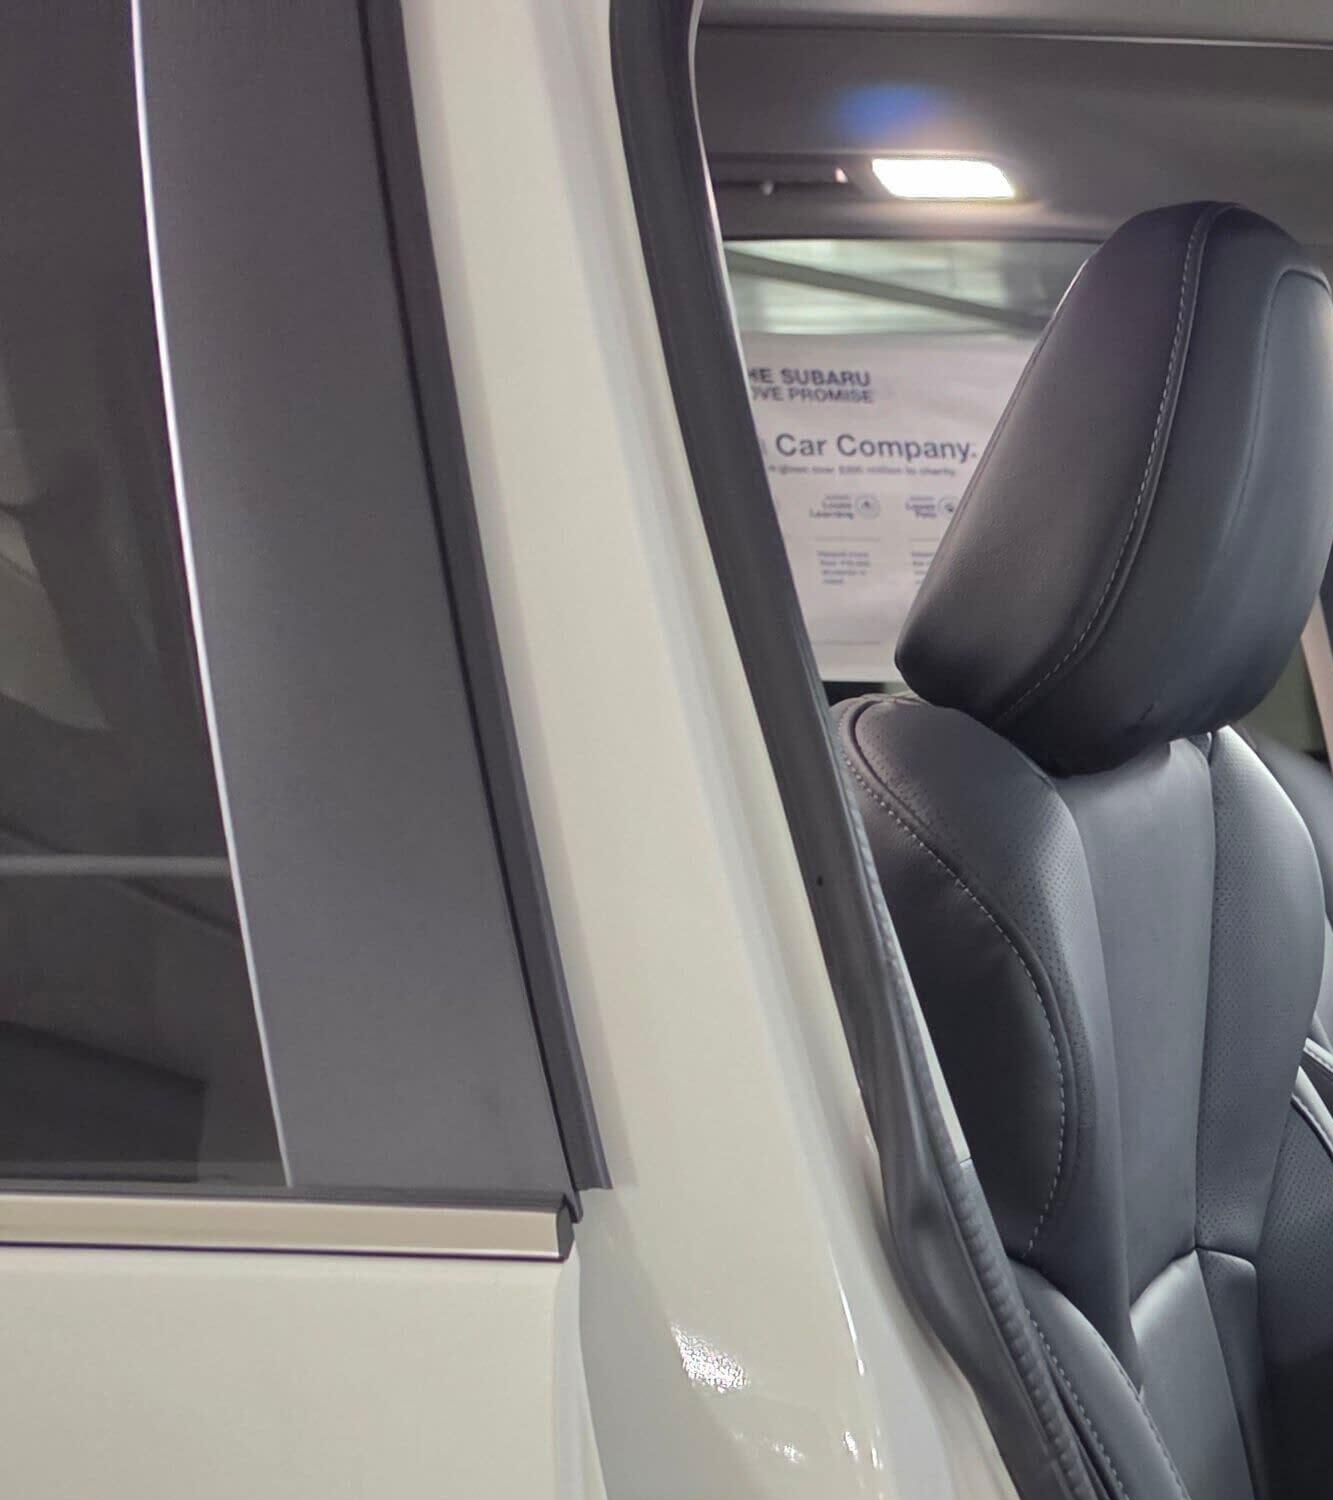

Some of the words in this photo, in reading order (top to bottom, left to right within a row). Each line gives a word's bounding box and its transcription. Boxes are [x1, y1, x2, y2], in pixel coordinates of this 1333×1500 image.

[750, 368, 774, 384] HE
[780, 368, 871, 388] SUBARU
[788, 386, 874, 404] PROMISE
[775, 433, 827, 457] Car
[836, 433, 977, 463] Company.
